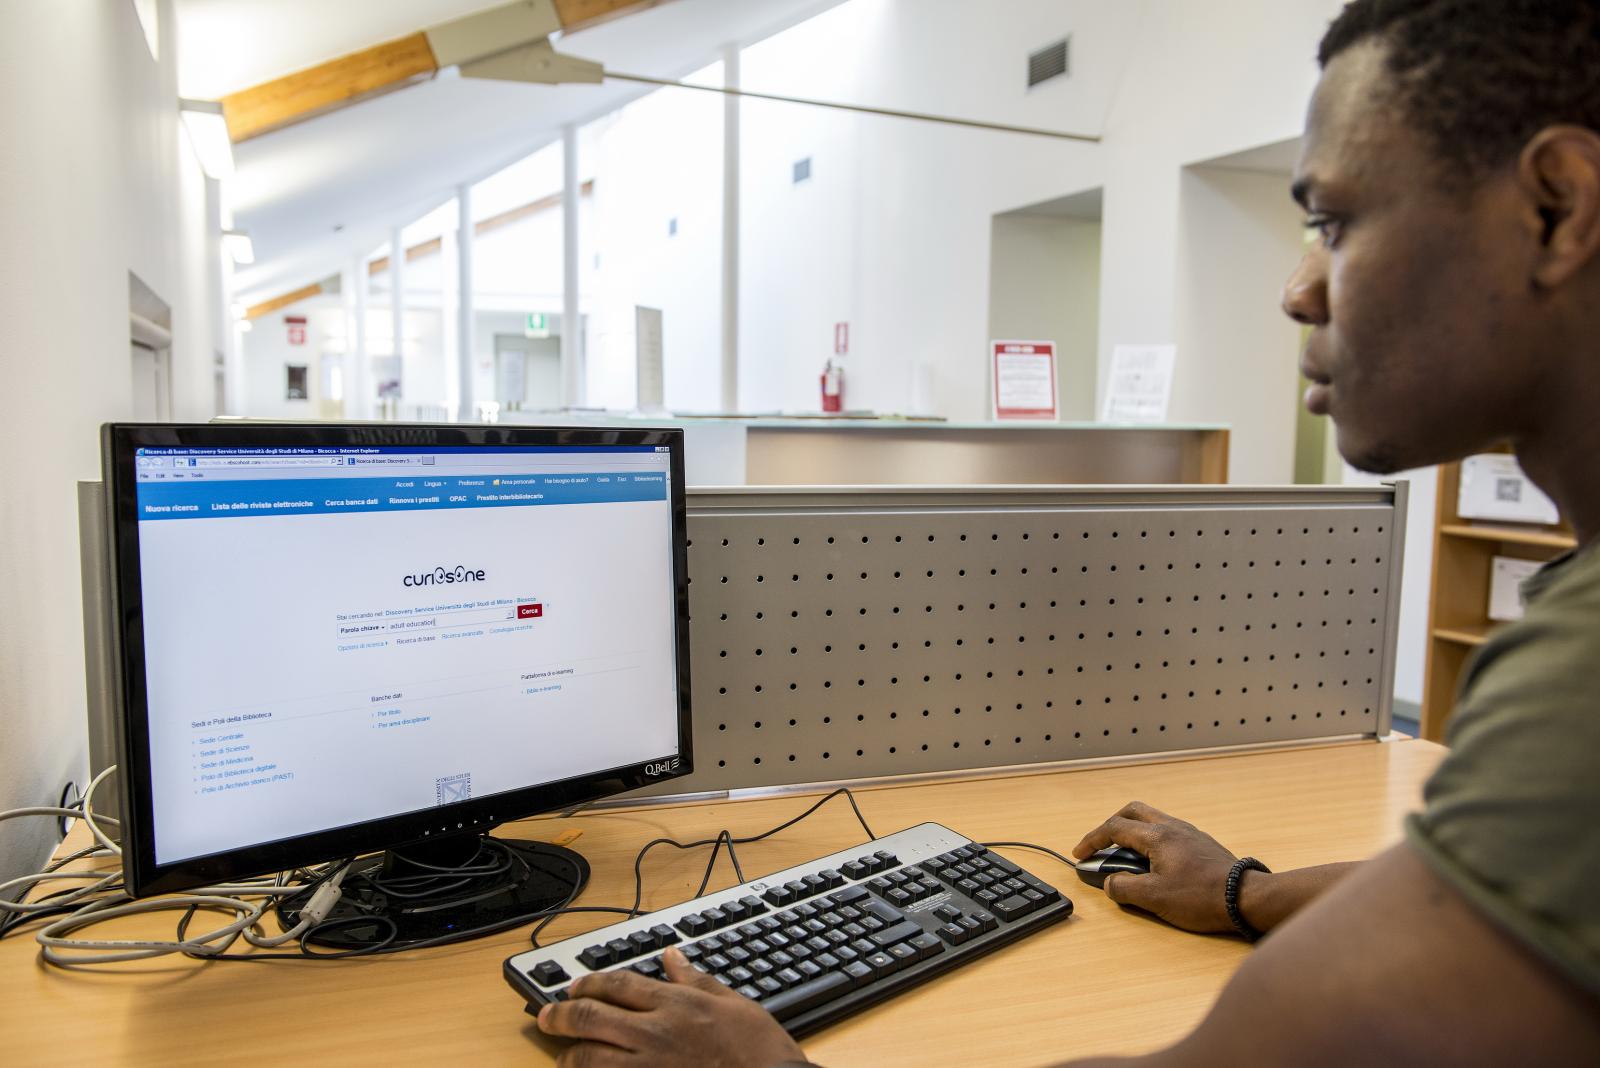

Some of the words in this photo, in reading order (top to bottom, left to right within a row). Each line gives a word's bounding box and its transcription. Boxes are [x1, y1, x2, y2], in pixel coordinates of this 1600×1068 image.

[348, 612, 373, 620] cercando
[390, 622, 405, 630] adult
[406, 619, 433, 628] education
[340, 626, 360, 634] Parola
[243, 712, 272, 721] Biblioteca
[217, 733, 244, 741] Centrale
[200, 749, 216, 757] Sede
[225, 744, 250, 753] Scienze
[225, 756, 253, 766] Medicina
[224, 768, 254, 777] Biblioteca
[255, 763, 277, 773] digitale
[201, 786, 217, 794] Polo
[224, 781, 249, 790] Archivio
[250, 777, 270, 785] storico
[272, 772, 294, 782] (PAST)
